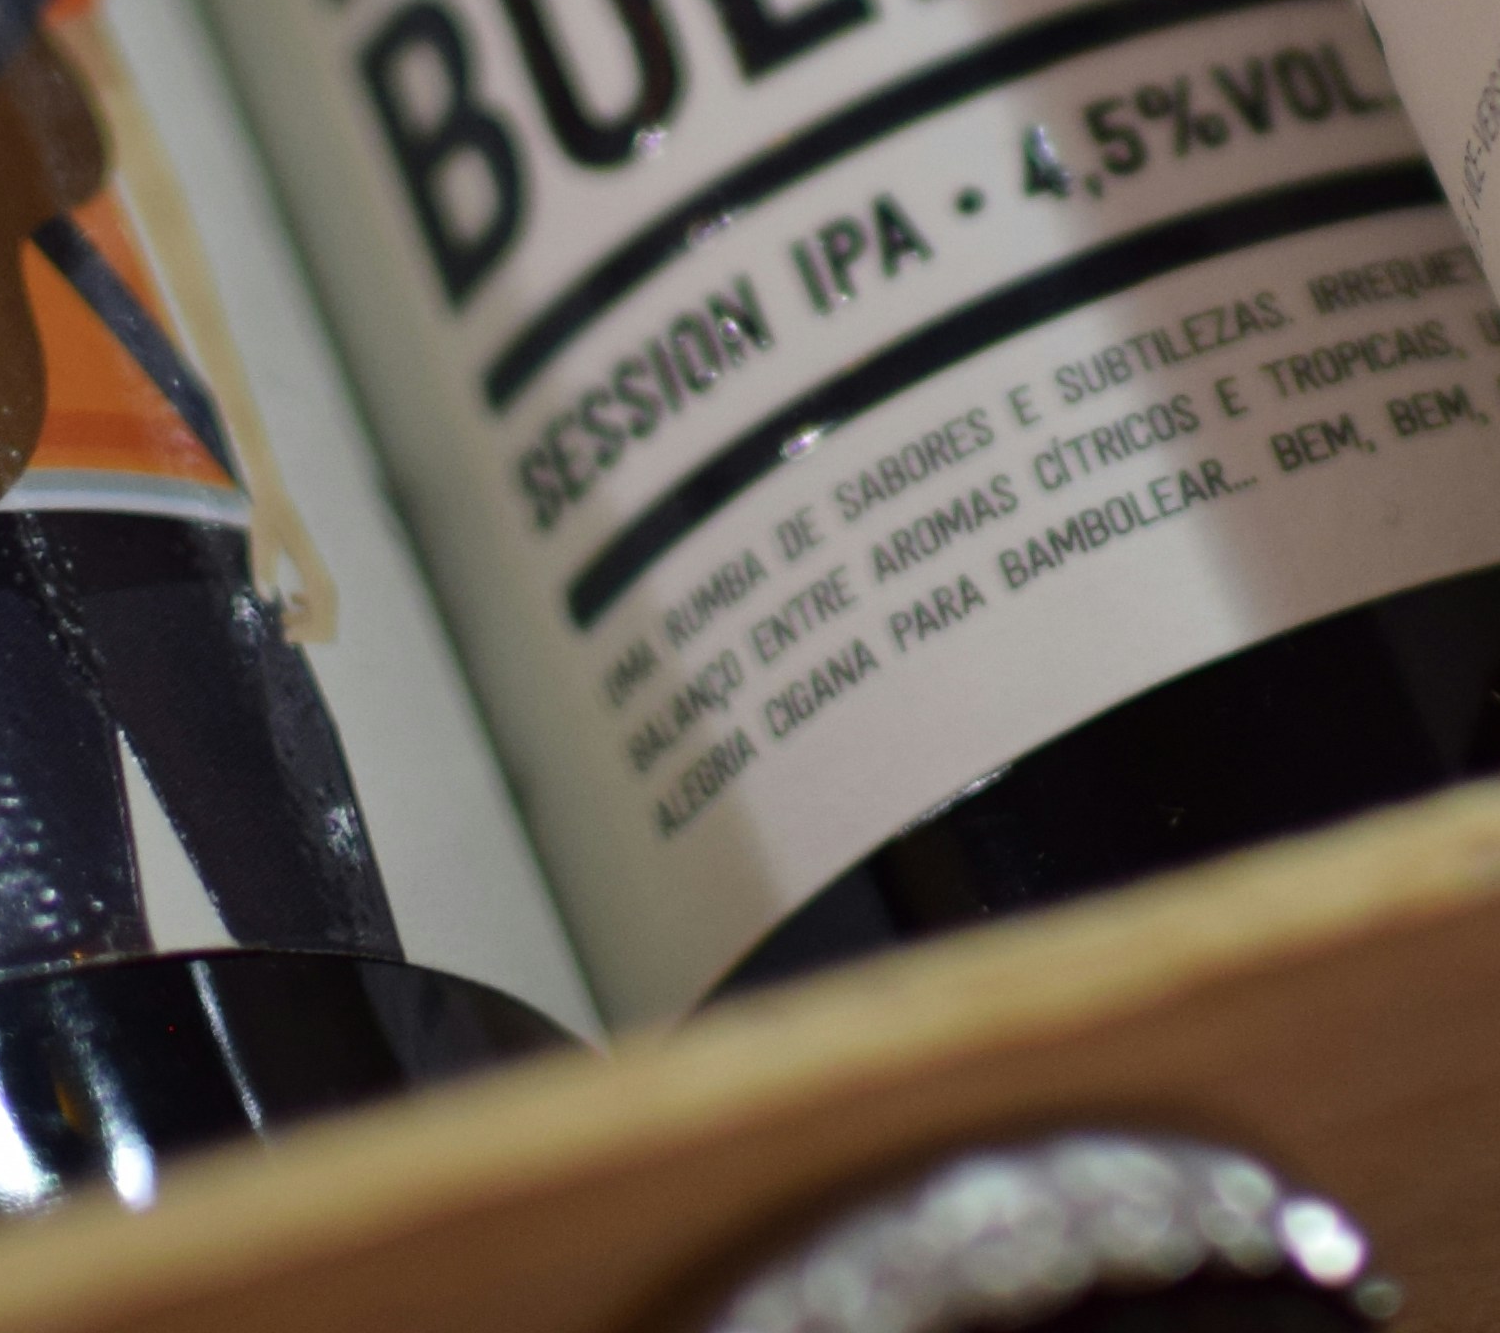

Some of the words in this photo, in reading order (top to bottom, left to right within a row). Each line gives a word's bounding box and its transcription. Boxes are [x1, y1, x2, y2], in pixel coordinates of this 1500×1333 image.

[516, 273, 775, 531] SESSION
[790, 191, 935, 317] IPA
[625, 647, 746, 774] BALANÇO
[750, 565, 857, 668] ENTRE
[871, 473, 1020, 586] AROMAS
[1033, 392, 1202, 493] CÍTRICOS
[1213, 376, 1248, 418] E
[1262, 320, 1470, 401] TROPICAIS,
[661, 548, 771, 653] RUMBA
[776, 505, 824, 564] DE
[835, 406, 997, 524] SABORES
[1007, 383, 1040, 427] E
[1054, 289, 1295, 406] SUBTILEZAS.
[654, 726, 759, 840] ALEGRIA
[762, 637, 881, 739] CIGANA
[889, 573, 988, 655] PARA
[1270, 412, 1377, 474] BEM,
[1386, 383, 1490, 439] BEM,
